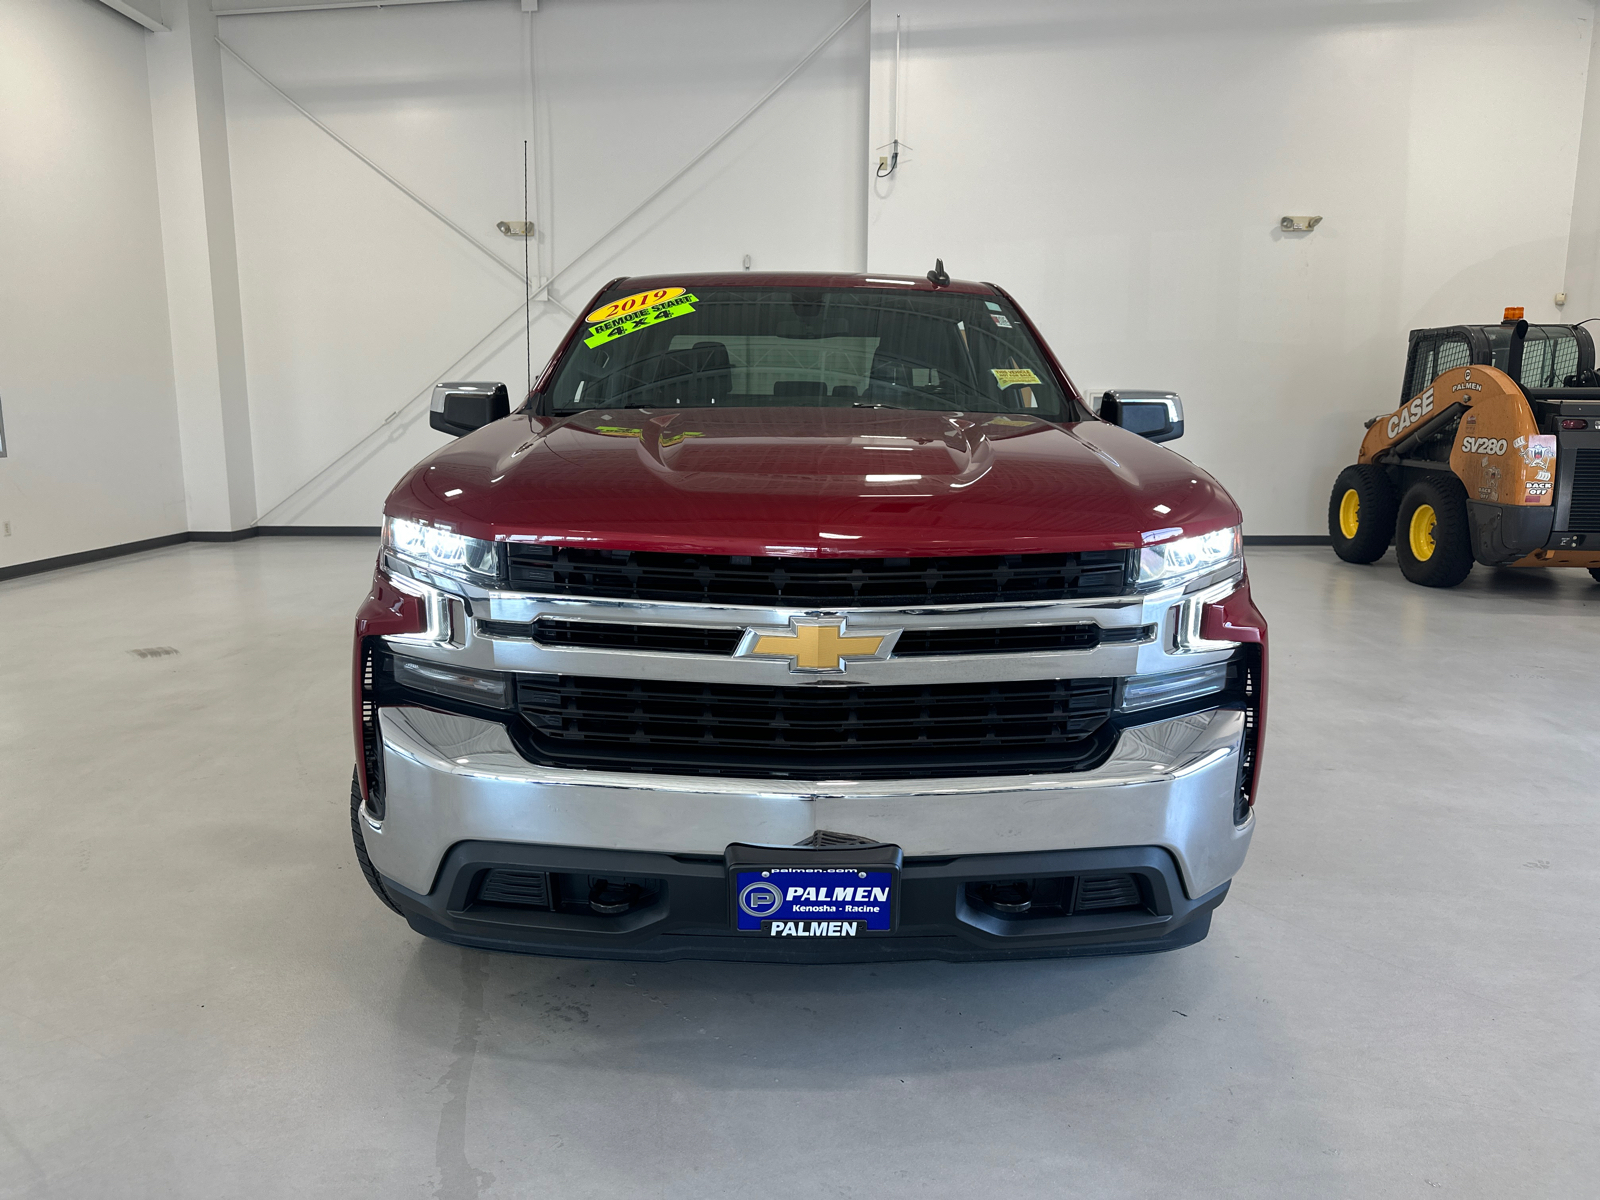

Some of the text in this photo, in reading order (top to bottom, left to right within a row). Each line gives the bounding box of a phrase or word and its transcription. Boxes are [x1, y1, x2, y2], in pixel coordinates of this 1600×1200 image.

[605, 290, 667, 318] 2019
[594, 295, 692, 334] REMOTE START
[1452, 382, 1482, 392] PALMEN
[1387, 387, 1434, 439] CASE
[1462, 436, 1507, 456] SV280
[786, 887, 889, 902] PALMEN
[792, 904, 836, 912] Kenosha
[845, 905, 880, 913] Racine
[770, 921, 858, 937] PALMEN
